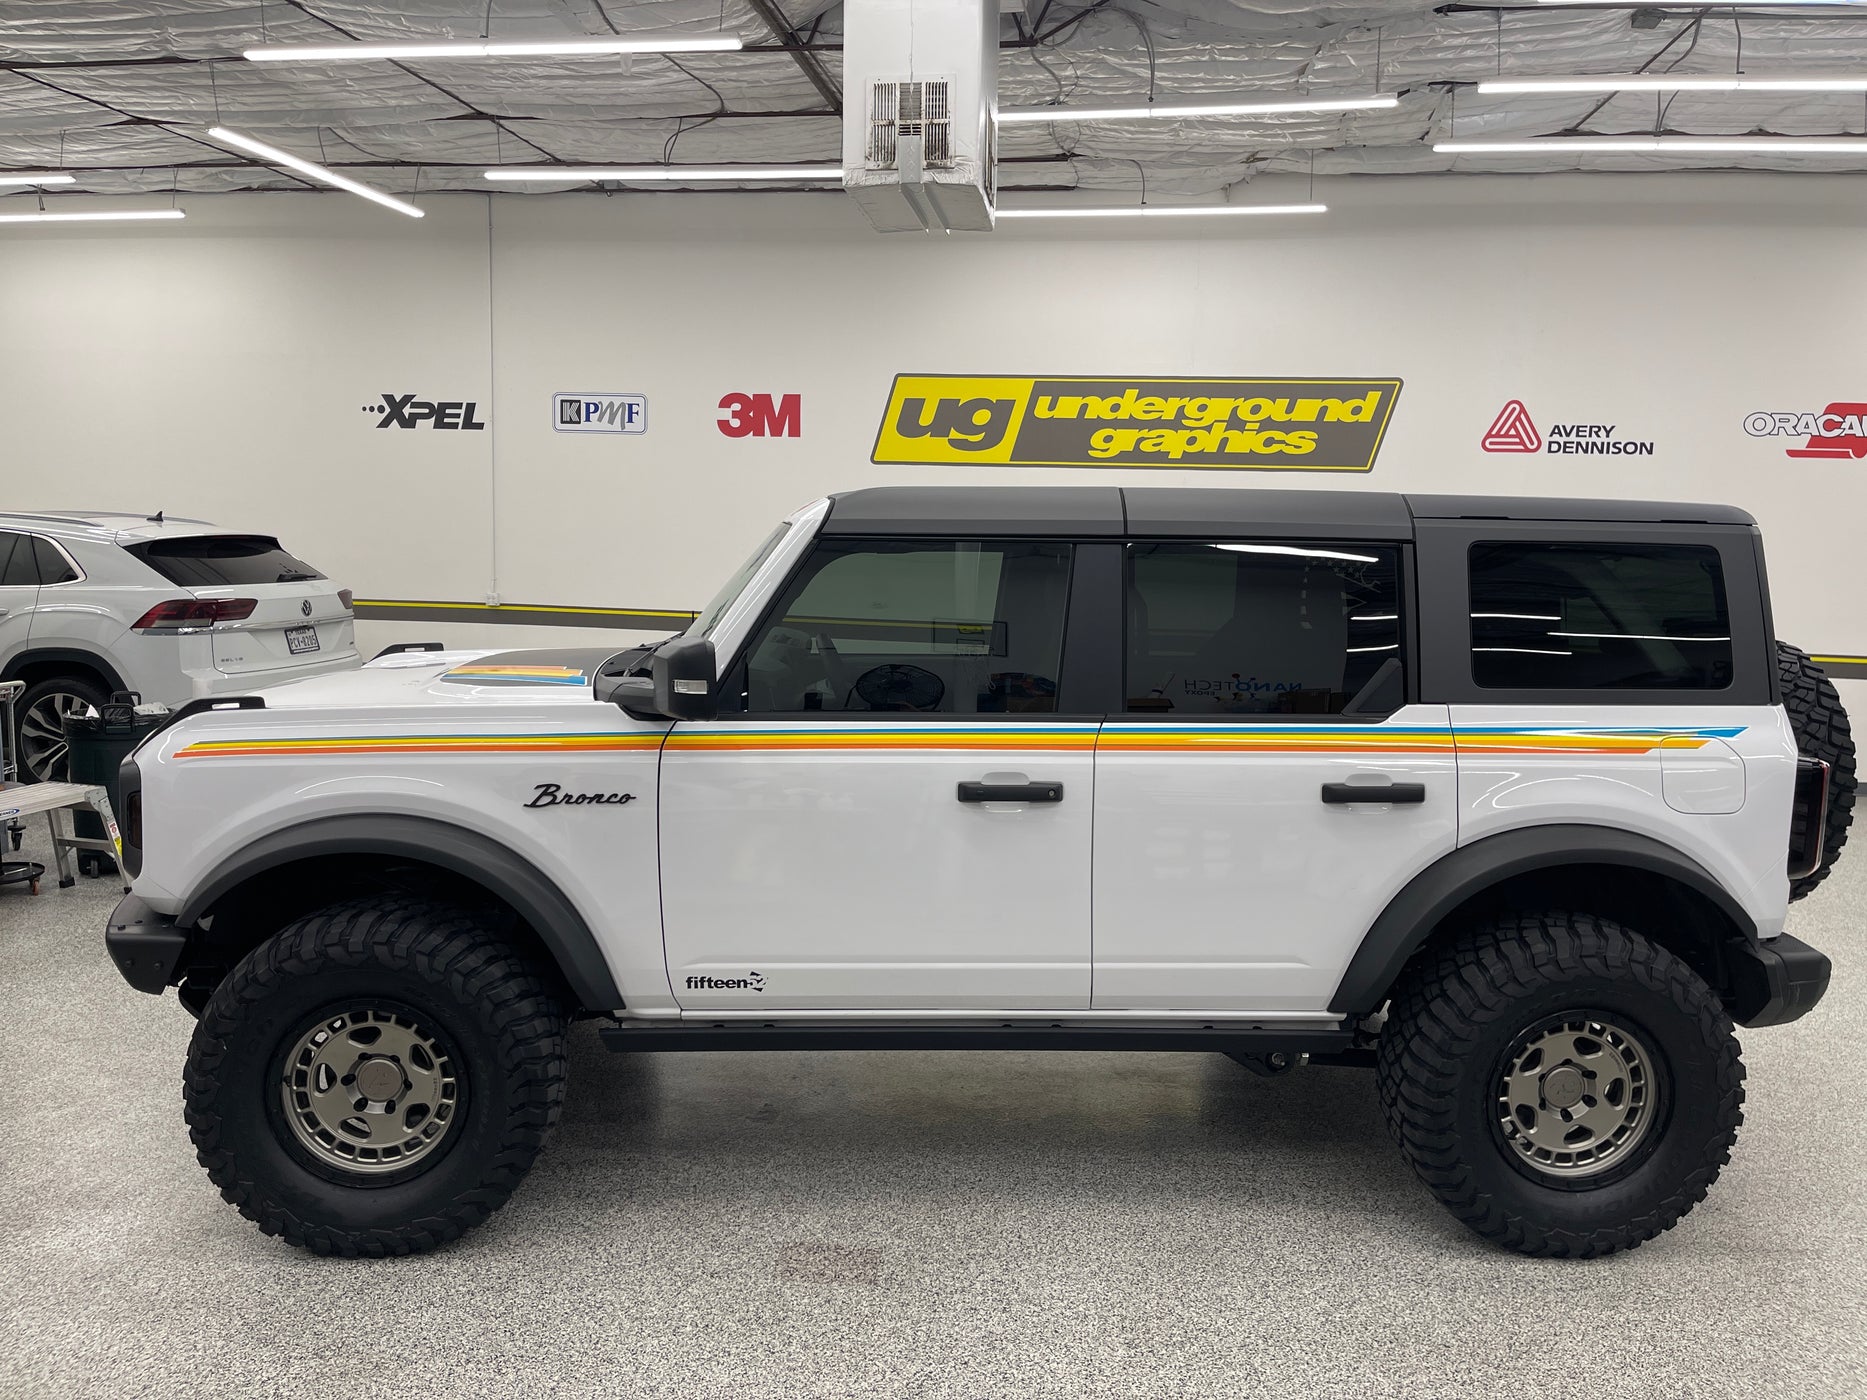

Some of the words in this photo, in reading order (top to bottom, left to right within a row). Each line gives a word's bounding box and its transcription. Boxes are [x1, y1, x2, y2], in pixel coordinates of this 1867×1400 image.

[376, 394, 485, 430] XPEL
[560, 399, 640, 430] KPMF
[717, 392, 801, 438] 3M
[896, 397, 1017, 452] ug
[1033, 388, 1383, 427] underground
[1087, 422, 1319, 459] graphics
[1547, 440, 1654, 455] DENNISON
[1549, 424, 1616, 438] AVERY
[523, 783, 637, 808] Bronco
